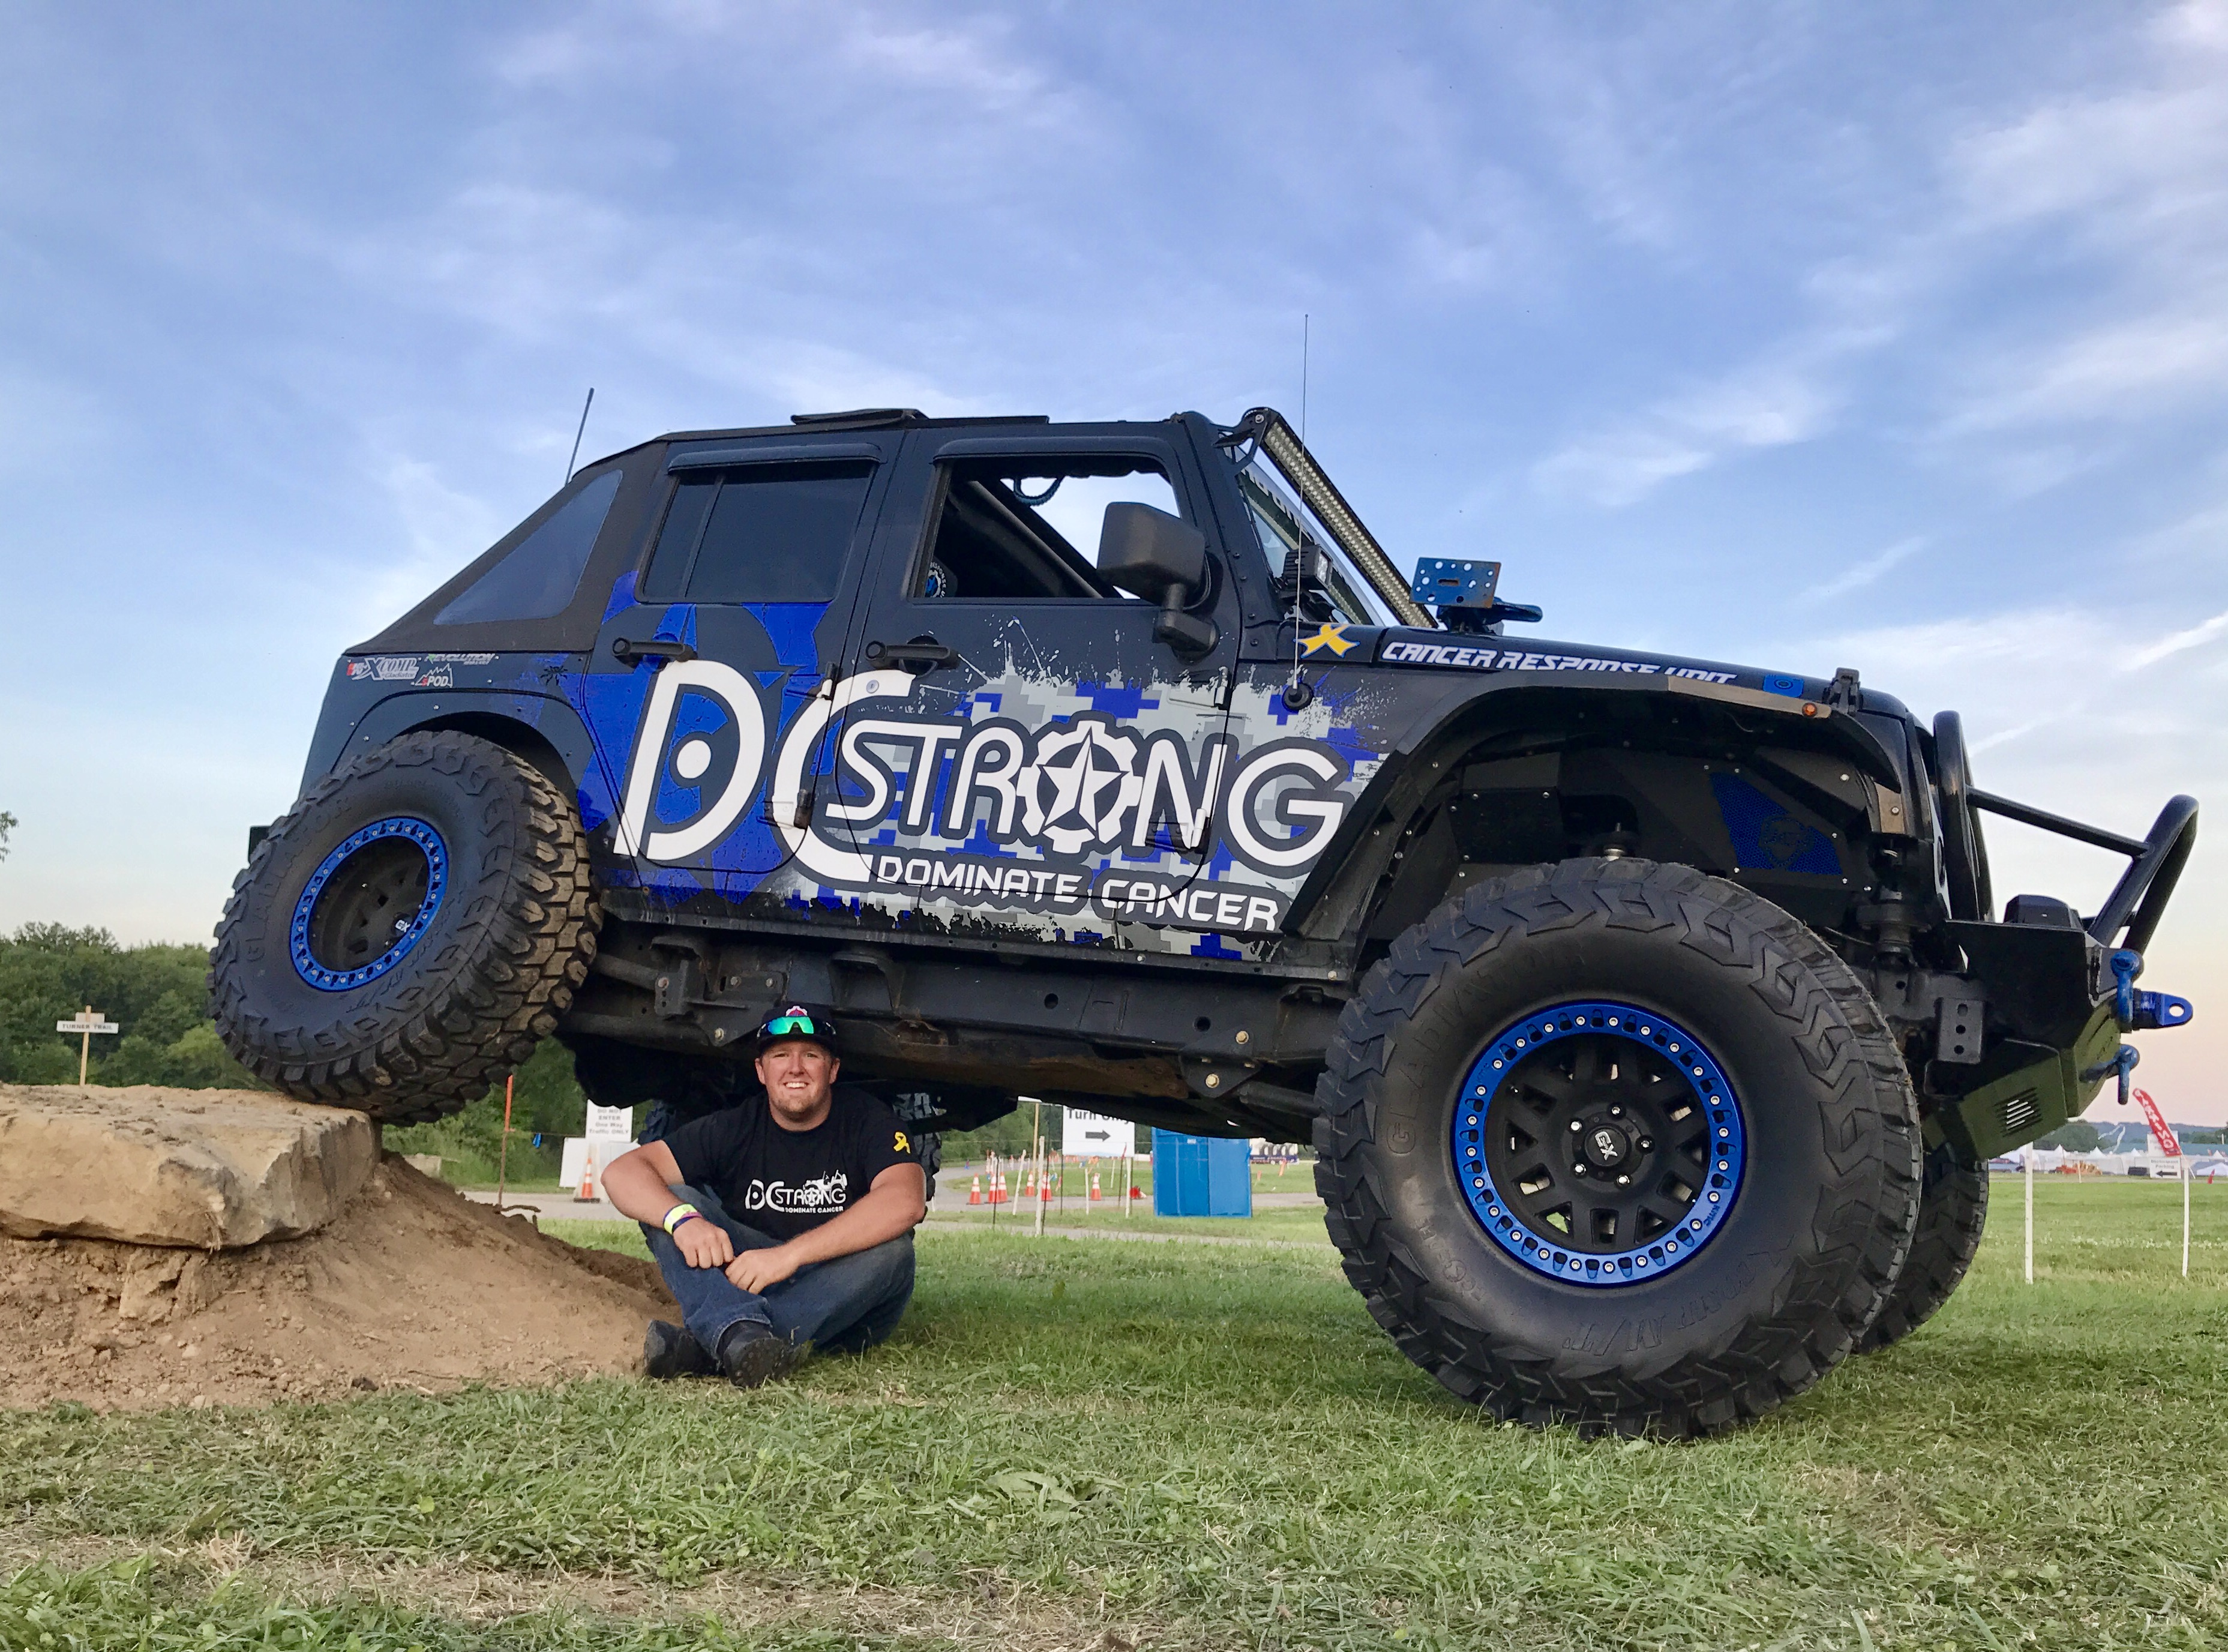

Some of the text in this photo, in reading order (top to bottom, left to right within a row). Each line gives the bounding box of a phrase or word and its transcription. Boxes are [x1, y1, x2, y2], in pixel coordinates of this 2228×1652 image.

[1381, 641, 1499, 668] CANCER
[878, 855, 1279, 932] DOMINATE CANCER
[1066, 1108, 1096, 1120] Turn
